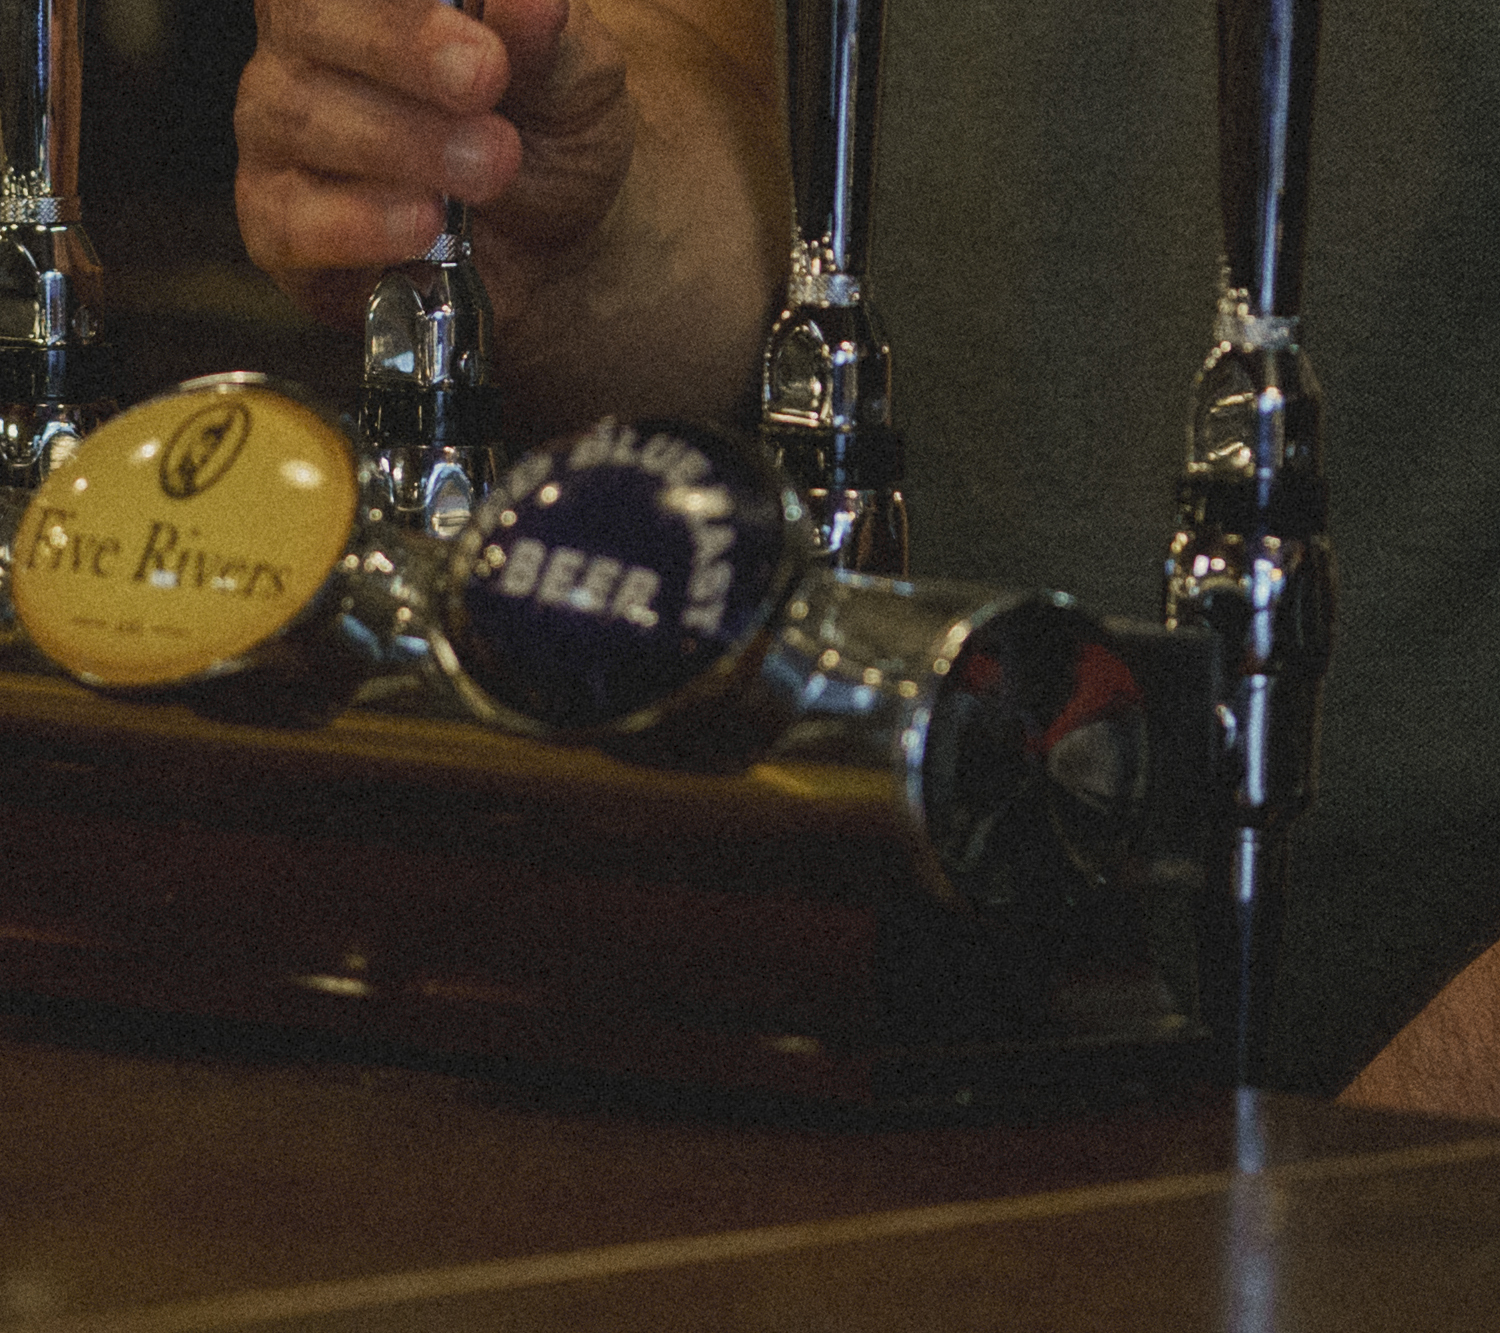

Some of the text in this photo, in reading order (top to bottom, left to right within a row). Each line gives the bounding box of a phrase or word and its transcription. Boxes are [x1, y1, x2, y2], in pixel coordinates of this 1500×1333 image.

[132, 518, 293, 598] Rivers
[500, 537, 662, 627] BEER
[676, 481, 731, 635] AST
